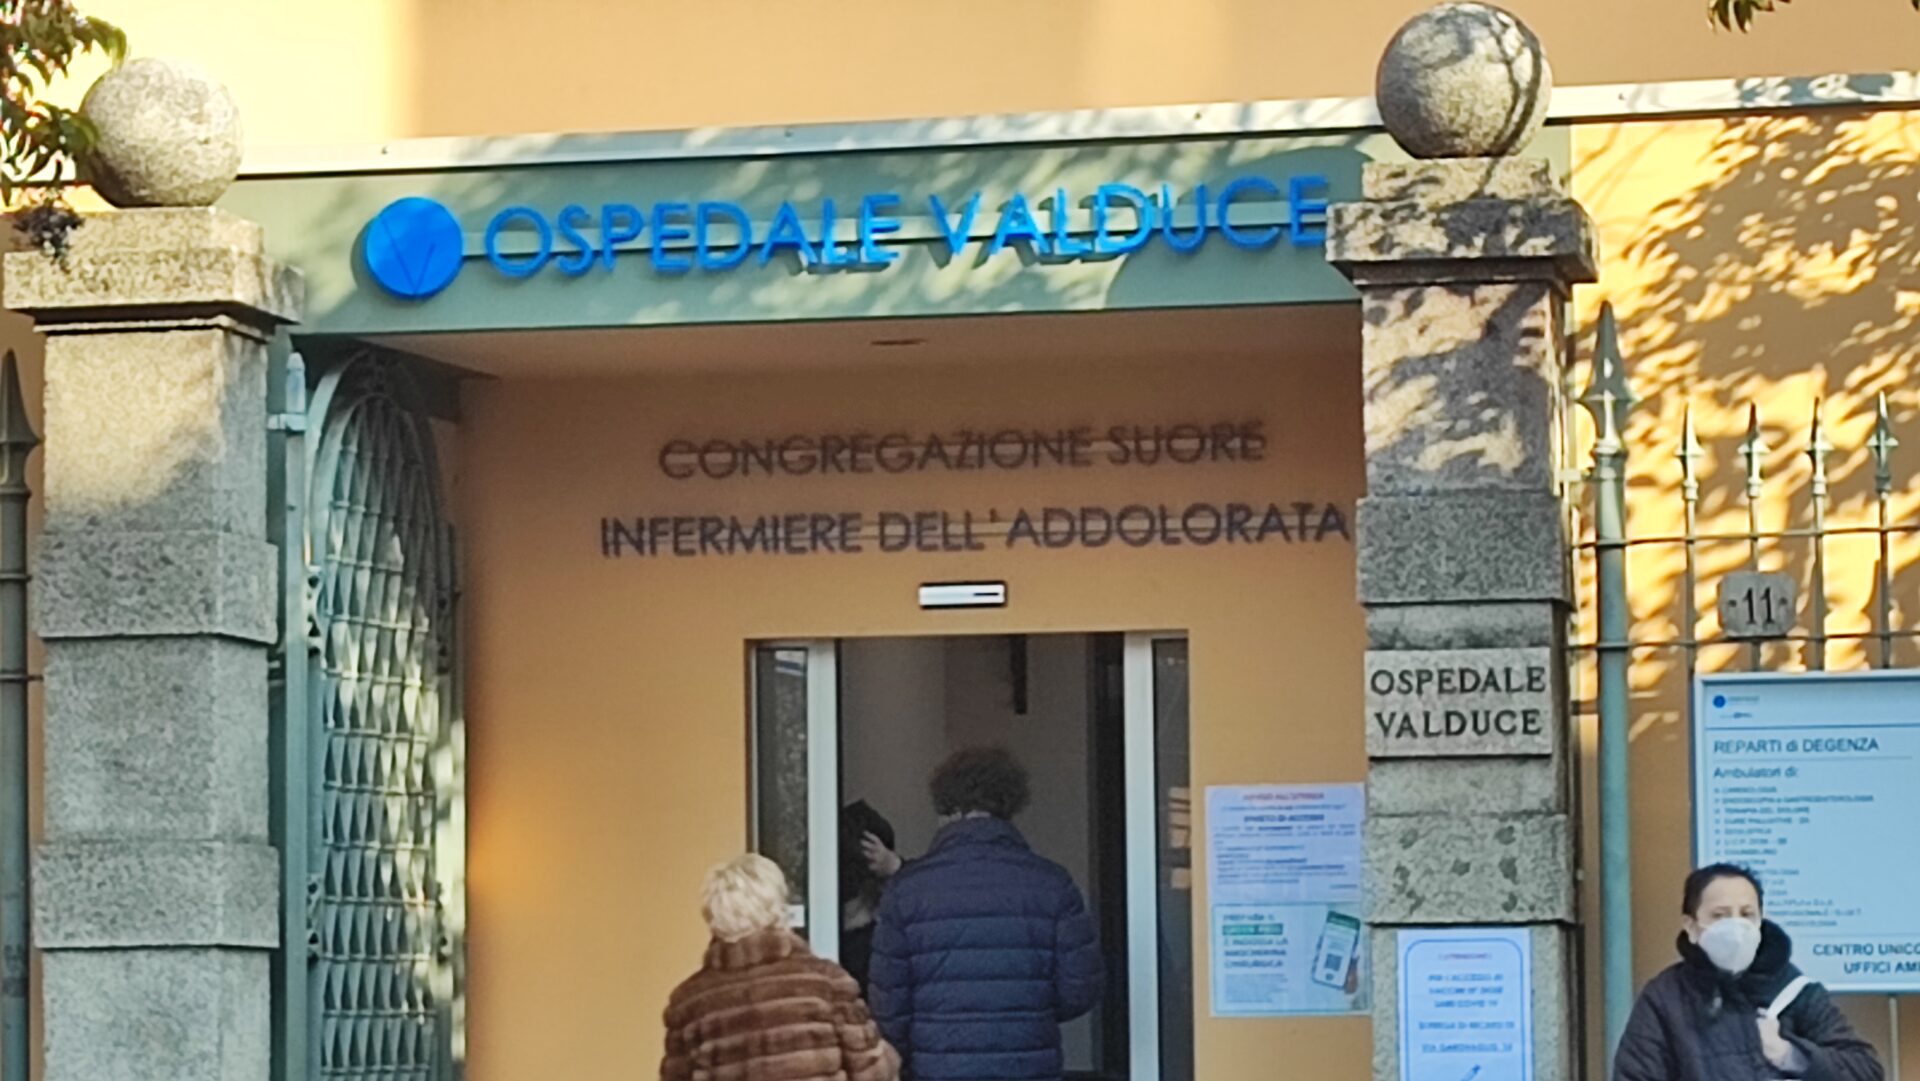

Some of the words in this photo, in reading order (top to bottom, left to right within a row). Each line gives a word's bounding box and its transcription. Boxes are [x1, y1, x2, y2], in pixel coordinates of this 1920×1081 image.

[484, 192, 901, 278] OSPEDALE
[929, 175, 1328, 256] VALDUCE
[658, 425, 1094, 480] CONGREGAZIONE
[1107, 420, 1268, 467] SUORE
[600, 511, 863, 558] INFERMIERE
[1370, 666, 1547, 696] OSPEDALE
[1374, 708, 1543, 739] VALDUCE
[1714, 739, 1781, 753] REPARTI
[1786, 739, 1799, 752] di
[1802, 737, 1879, 752] DEGENZA
[1812, 943, 1874, 957] CENTRO
[1843, 961, 1891, 975] UFFICI
[1894, 960, 1920, 974] AM
